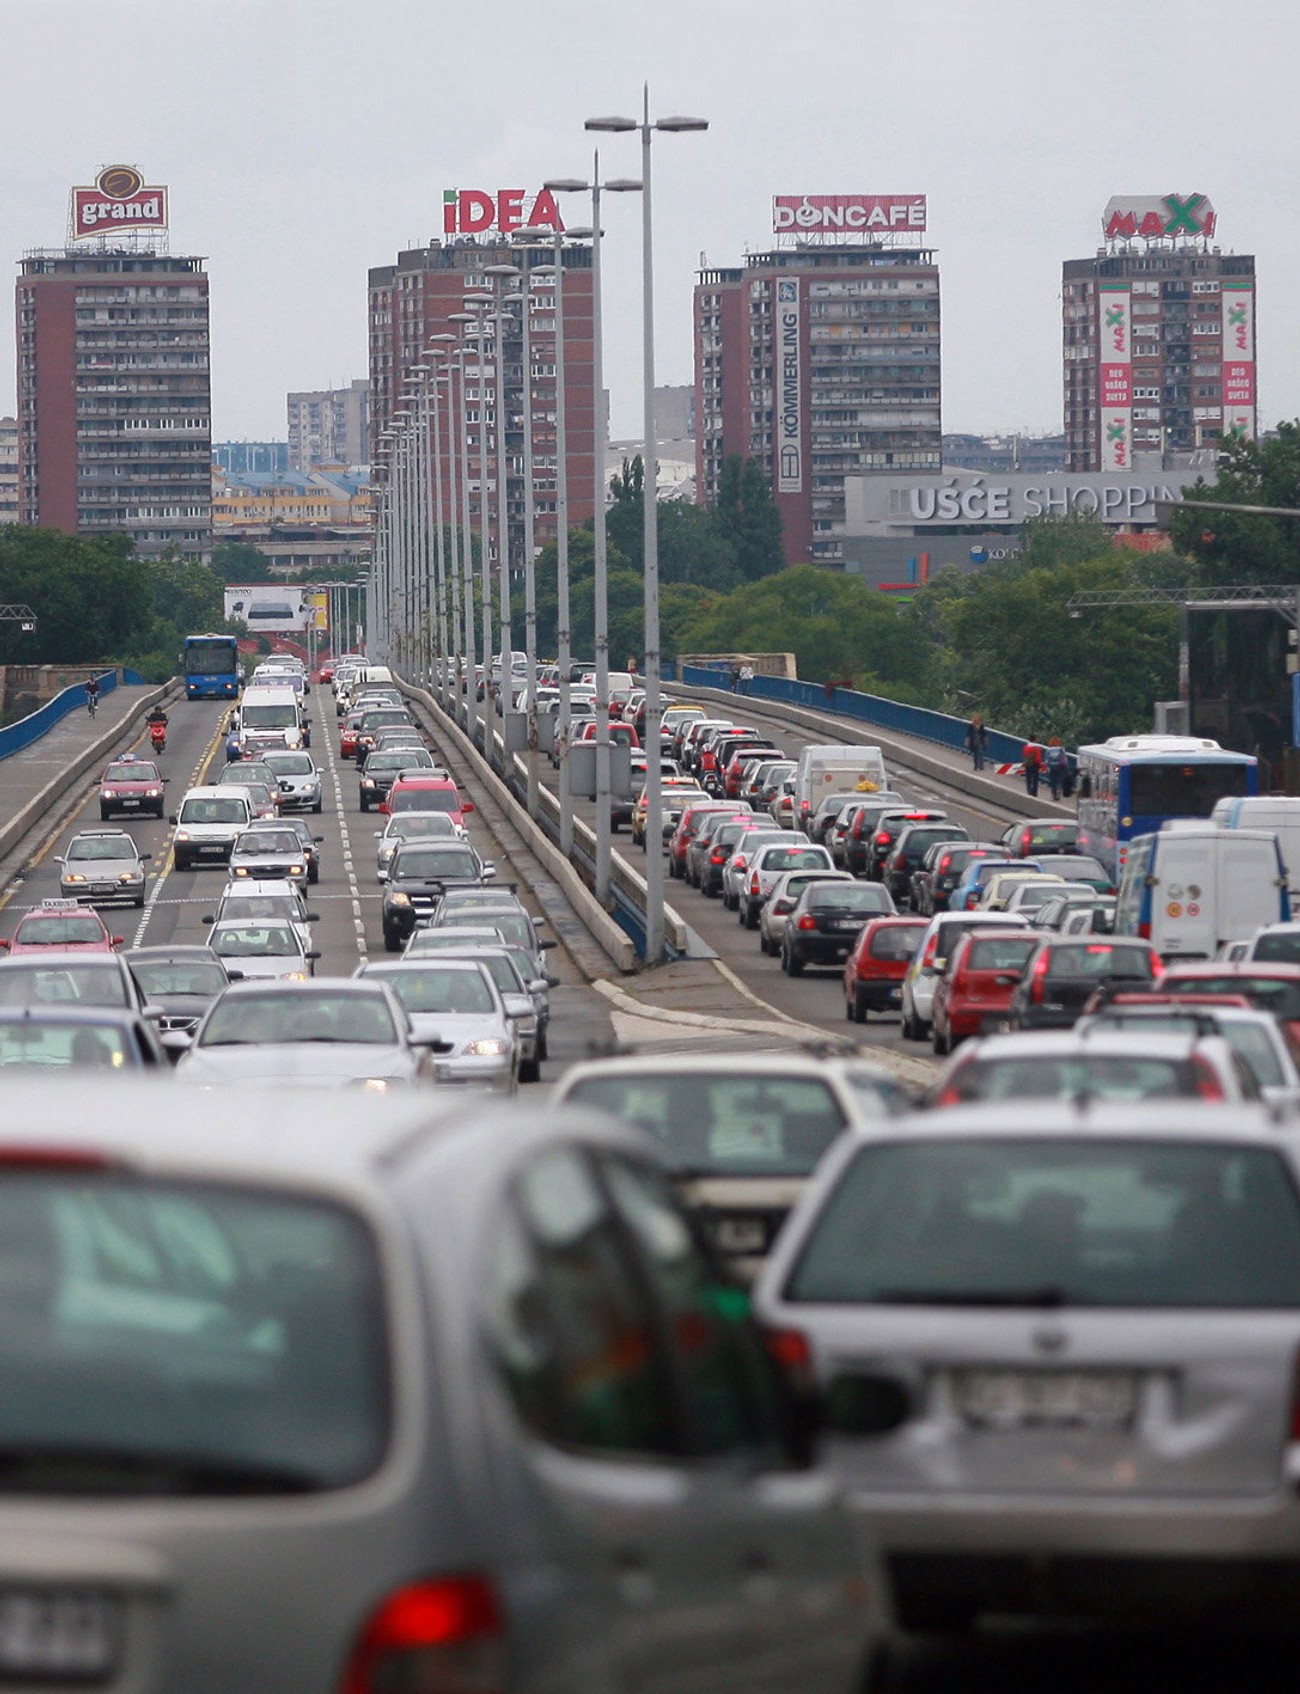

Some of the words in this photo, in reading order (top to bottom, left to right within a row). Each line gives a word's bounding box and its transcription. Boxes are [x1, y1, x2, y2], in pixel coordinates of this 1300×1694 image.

[82, 198, 160, 225] grand
[775, 197, 926, 228] DONCAFÉ
[1104, 192, 1217, 239] MAXI
[780, 313, 799, 439] KÖMMERLING
[909, 478, 1011, 520] UŠĆE
